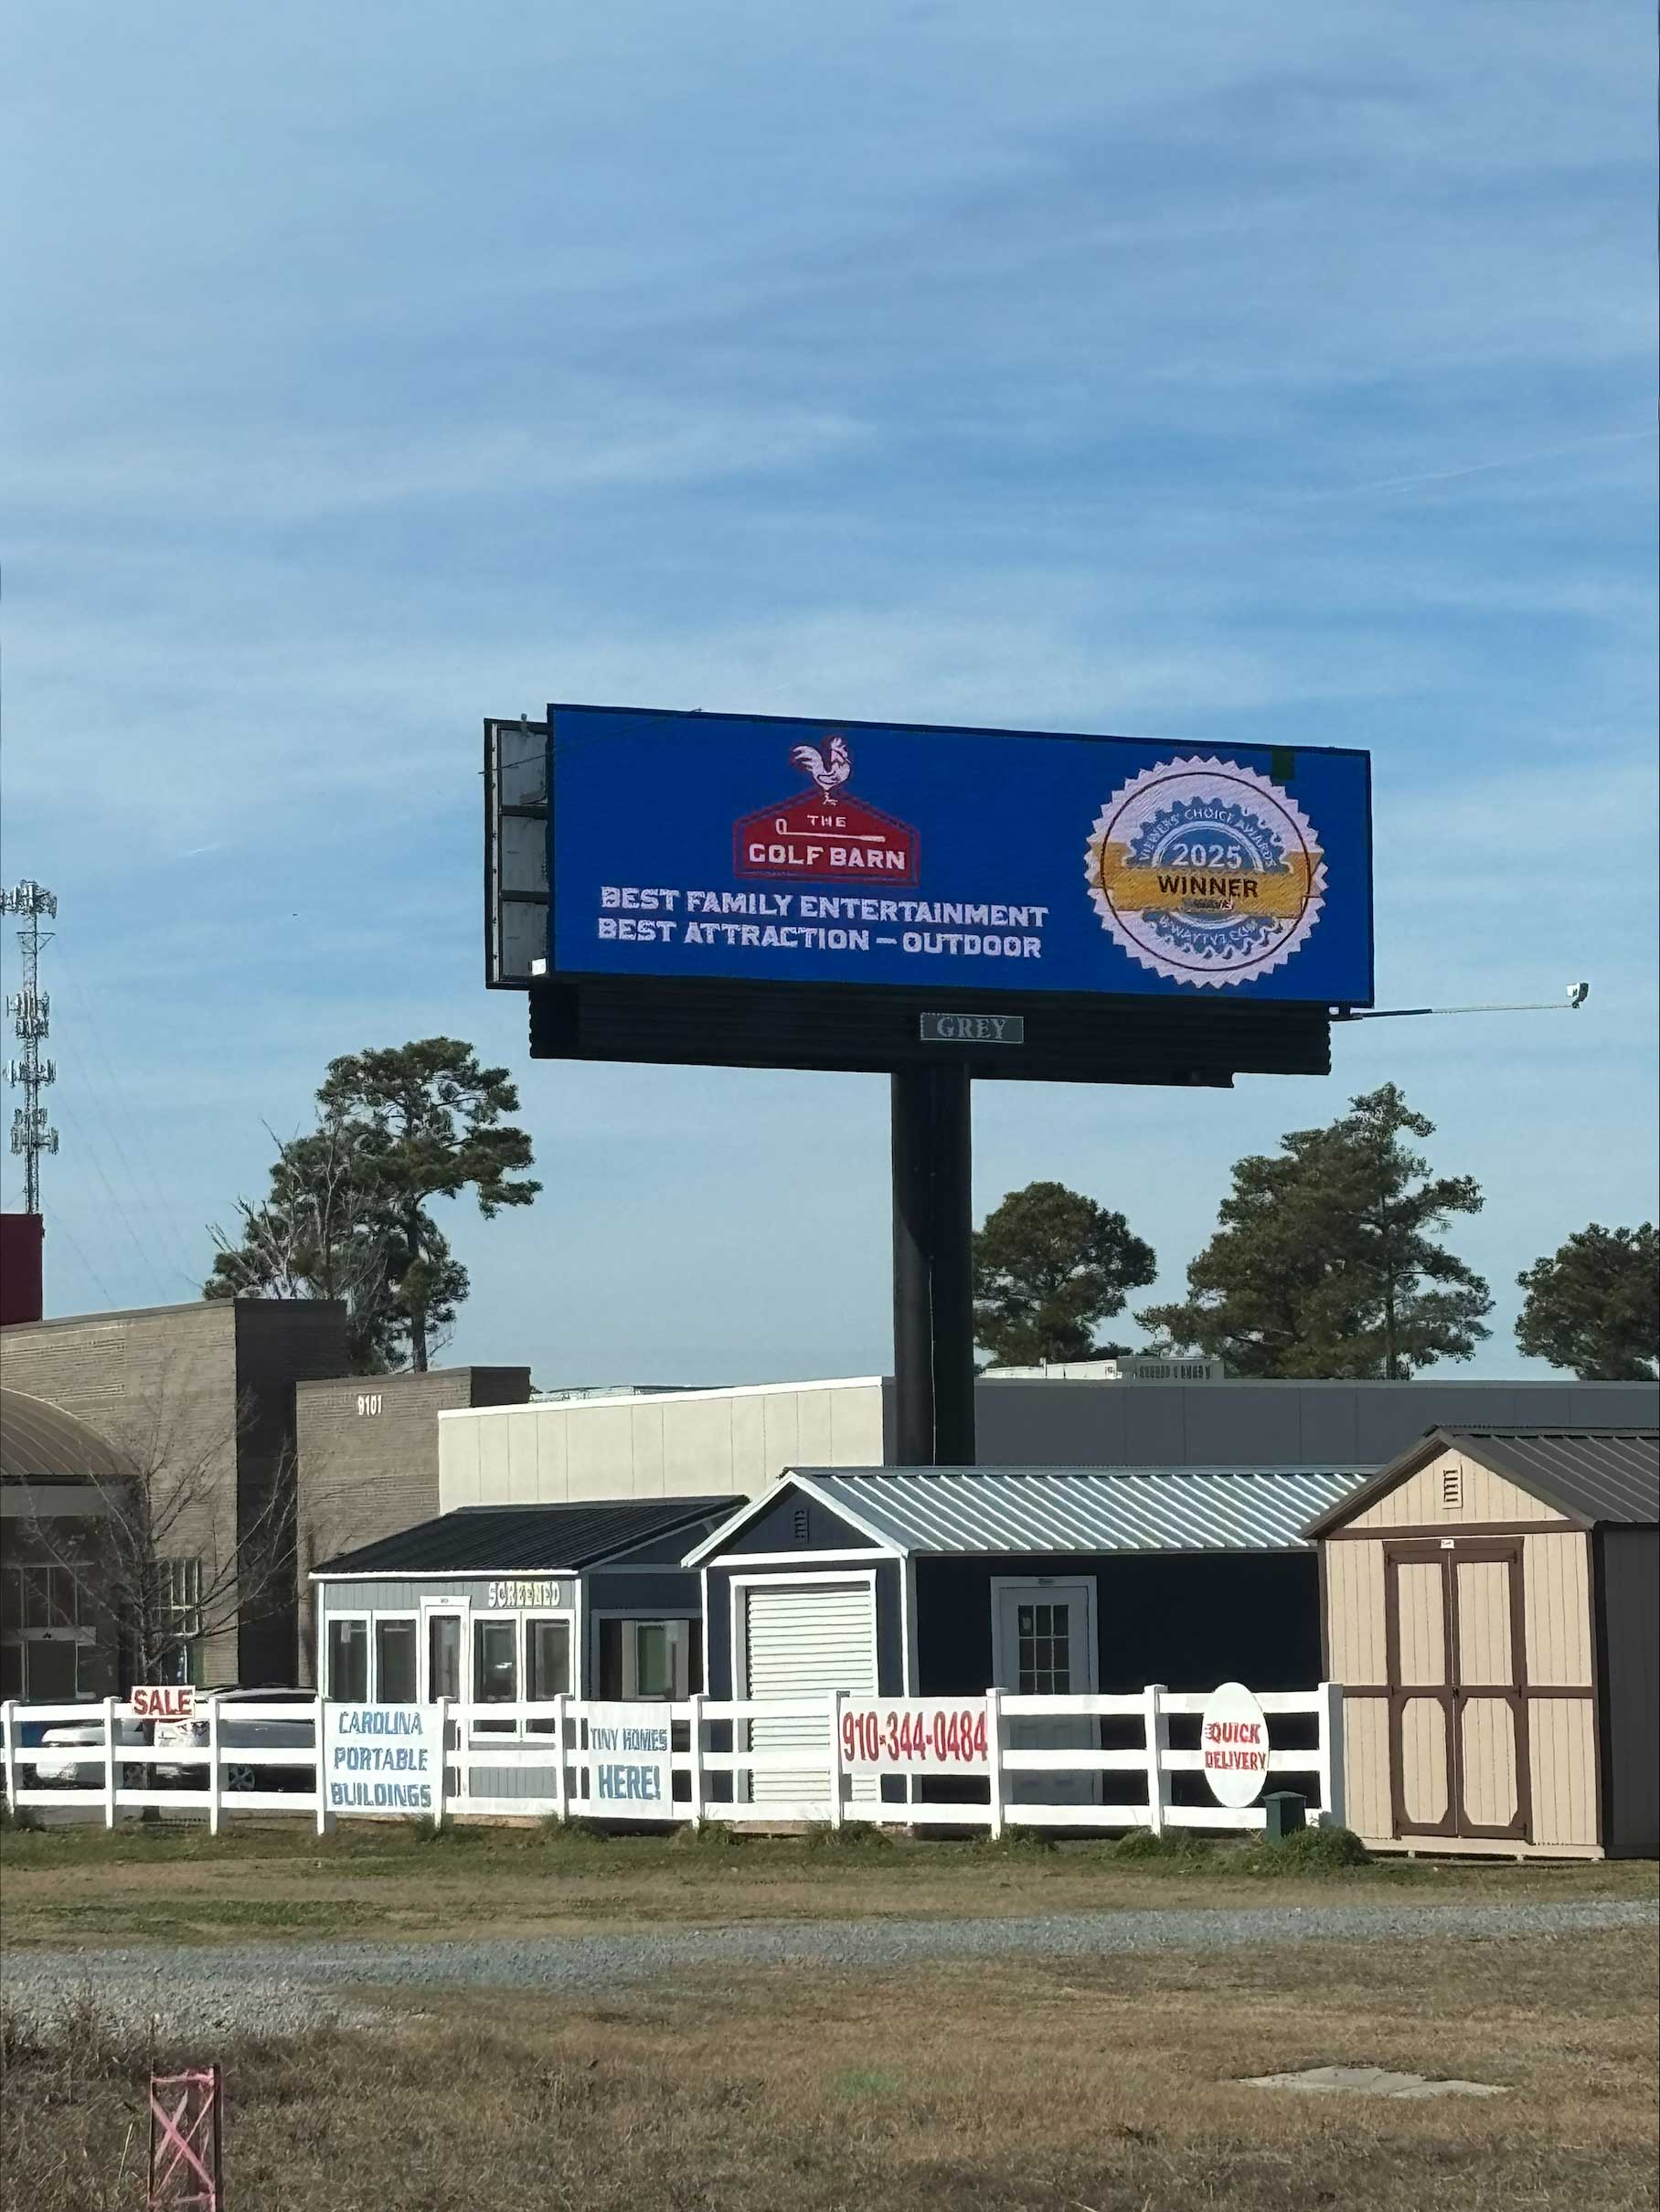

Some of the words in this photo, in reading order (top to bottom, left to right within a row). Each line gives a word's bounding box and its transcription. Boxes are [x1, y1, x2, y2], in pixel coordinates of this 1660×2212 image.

[806, 814, 846, 828] THE
[749, 843, 824, 866] GOLF
[830, 846, 906, 870] BARN
[1172, 843, 1242, 869] 2025
[1157, 875, 1259, 898] WINNER
[601, 886, 680, 911] BEST
[686, 890, 793, 916] FAMILY
[800, 895, 1050, 928] ENTERTAINMENT
[598, 917, 676, 942] BEST
[684, 921, 869, 951] ATTRACTION
[902, 931, 1041, 959] OUTDOOR
[937, 1016, 1006, 1039] GREY
[133, 1689, 193, 1715] SALE
[339, 1711, 422, 1735] CAROLINA
[1209, 1722, 1261, 1744] QUICK
[591, 1728, 618, 1750] TINY
[622, 1728, 667, 1750] HOMES
[842, 1710, 988, 1761] 910-344-0484
[334, 1747, 428, 1771] PORTABLE
[1205, 1750, 1266, 1771] DELIVERY
[599, 1764, 661, 1800] HERE!
[331, 1782, 431, 1807] BUILDINGS
